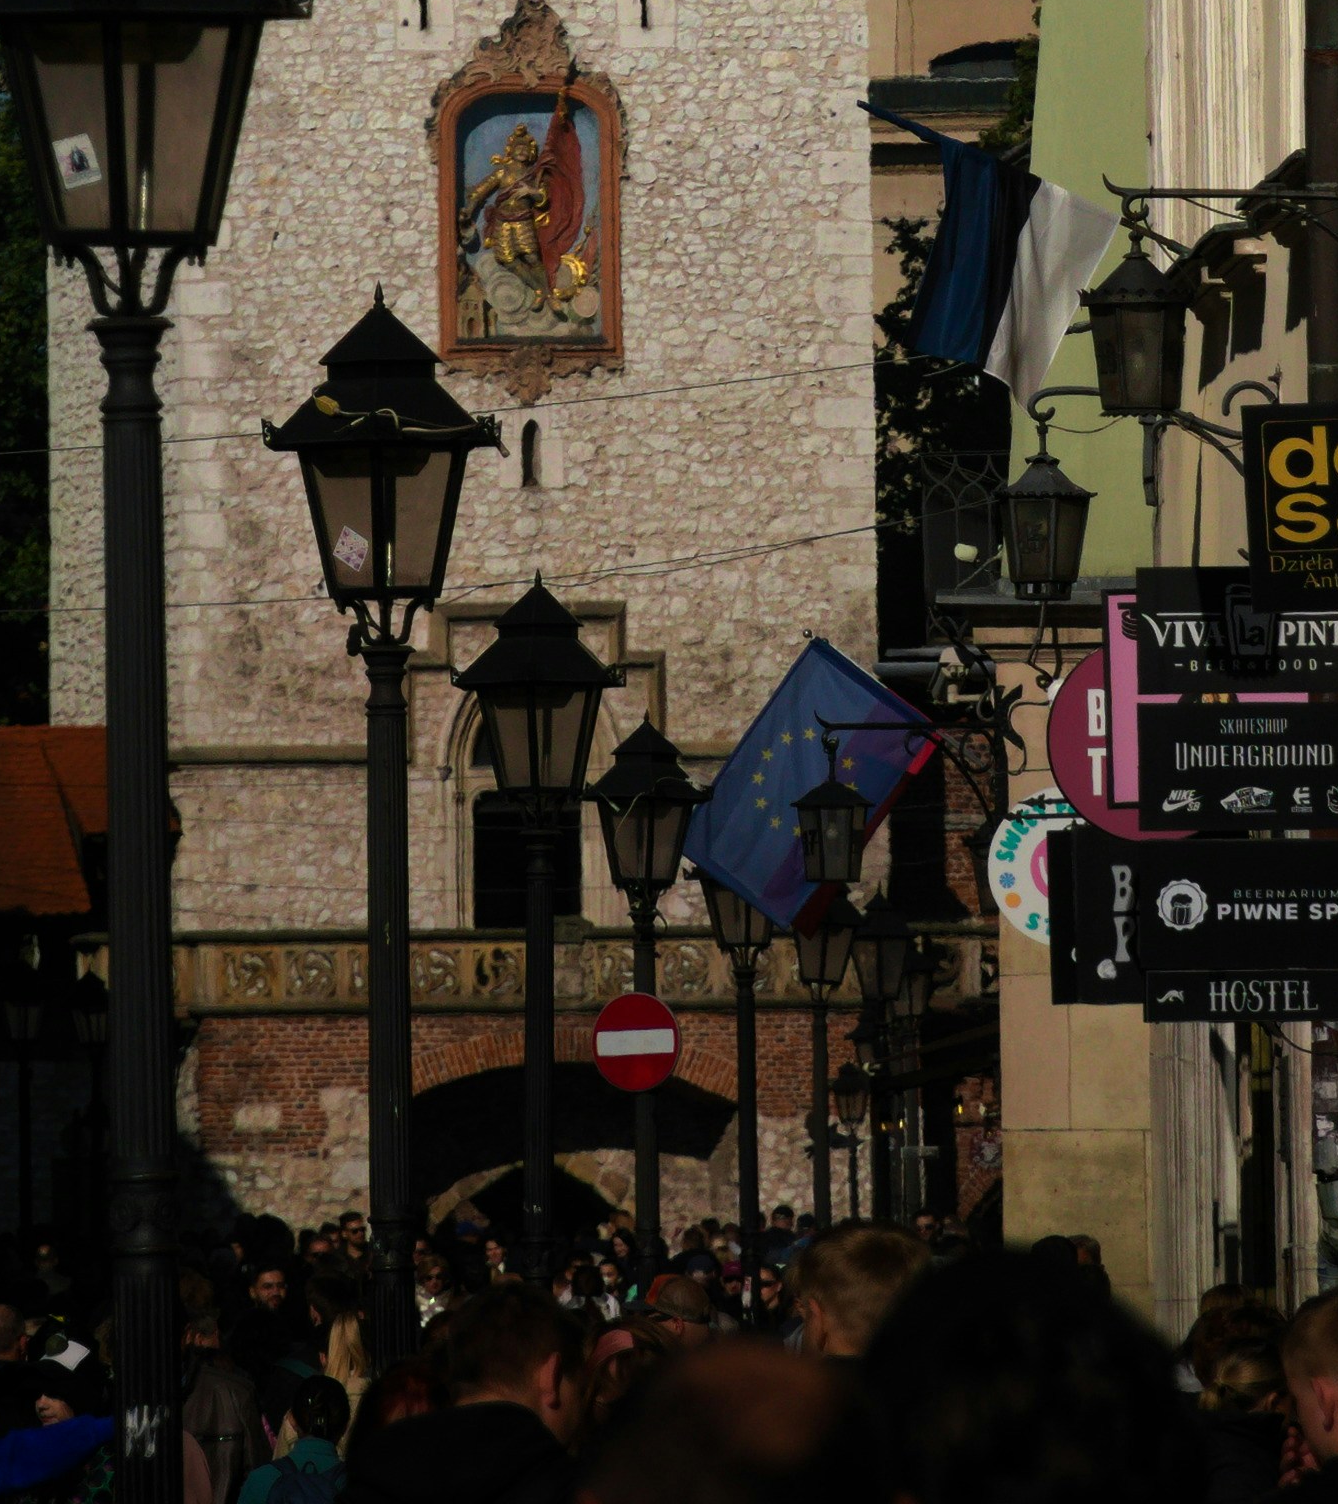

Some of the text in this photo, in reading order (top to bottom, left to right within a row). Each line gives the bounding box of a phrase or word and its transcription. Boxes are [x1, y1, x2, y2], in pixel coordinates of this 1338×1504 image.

[1141, 613, 1225, 648] VIVA
[1220, 718, 1289, 735] SKATESHOP
[1175, 742, 1334, 771] UNDERGROUND
[1168, 789, 1197, 801] NIKE
[1217, 903, 1299, 920] PIWNE
[1209, 980, 1319, 1012] HOSTEL
